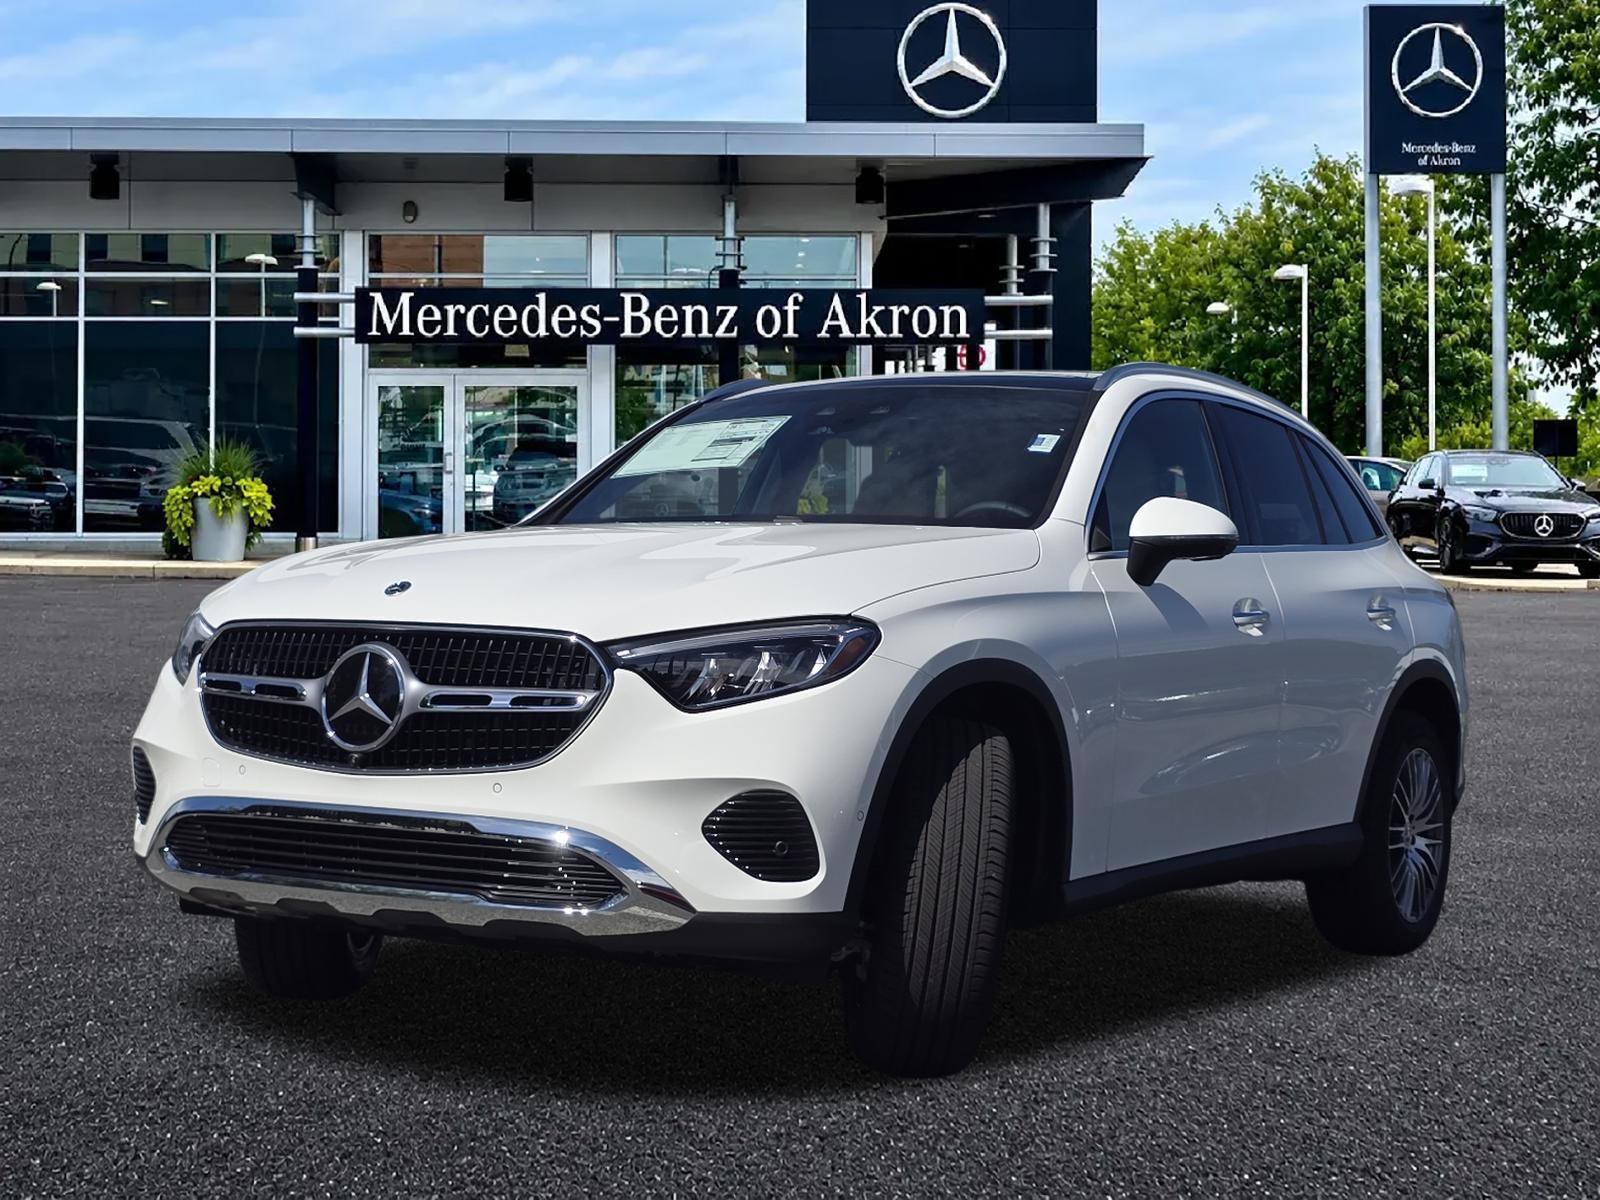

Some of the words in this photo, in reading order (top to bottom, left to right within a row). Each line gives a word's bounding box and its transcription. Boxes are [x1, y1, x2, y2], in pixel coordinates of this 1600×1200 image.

[1401, 142, 1476, 153] Mercedes-Benz
[1418, 154, 1428, 166] of
[1430, 154, 1461, 166] Akron
[367, 291, 738, 338] Mercedes-Benz
[756, 292, 804, 338] of
[816, 292, 971, 338] Akron
